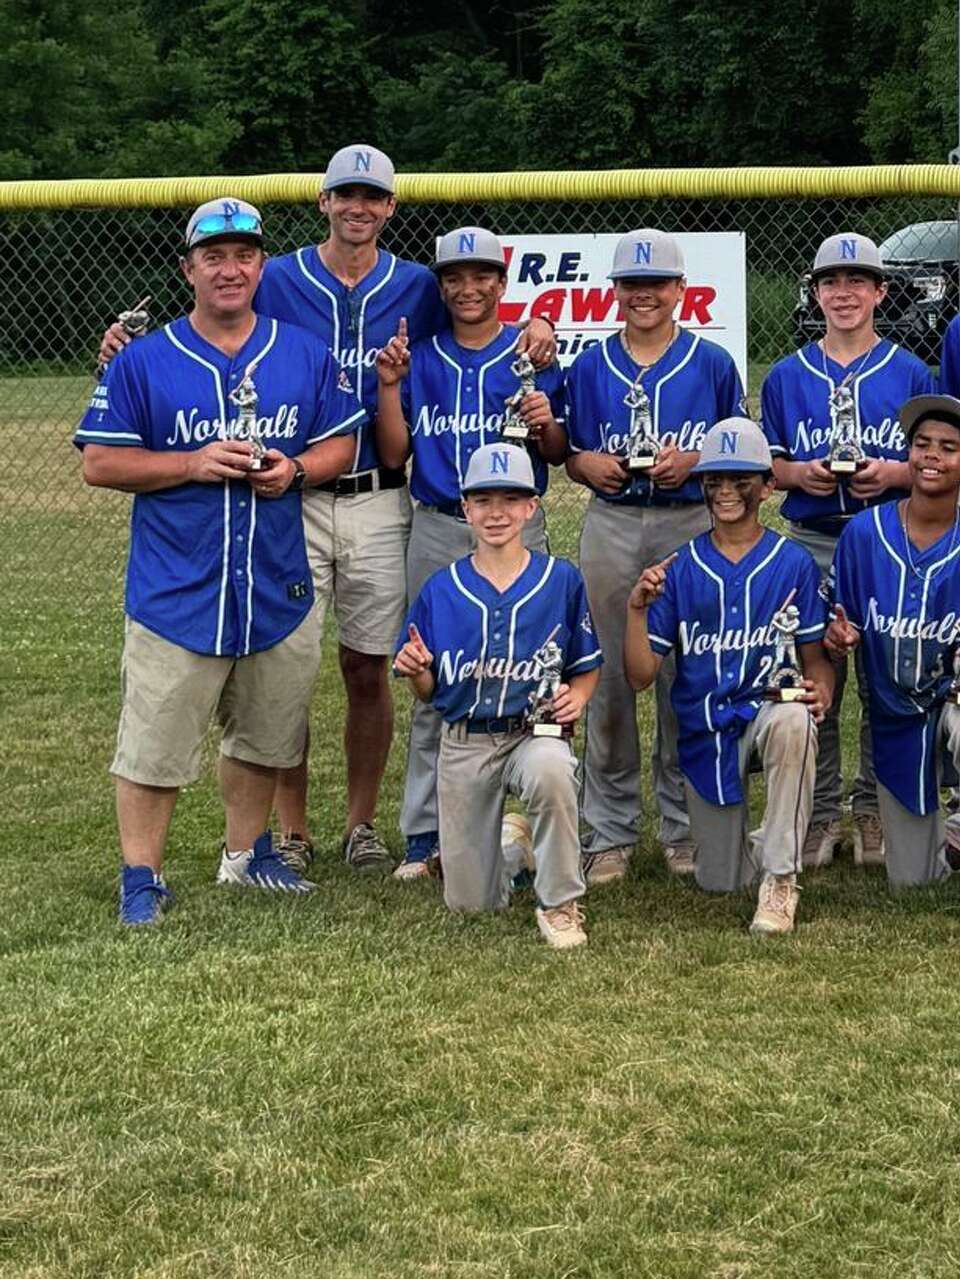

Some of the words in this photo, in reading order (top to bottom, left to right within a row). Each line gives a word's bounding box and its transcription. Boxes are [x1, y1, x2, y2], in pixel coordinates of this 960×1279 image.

[354, 151, 371, 171] N
[458, 233, 476, 253] N
[634, 242, 652, 264] N
[839, 239, 857, 259] N
[518, 252, 589, 286] R.E.
[411, 405, 504, 437] Norwa
[598, 420, 708, 454] Noralk
[720, 431, 739, 454] N
[490, 452, 510, 474] N
[680, 620, 780, 655] Norwal
[439, 649, 545, 686] Norwa
